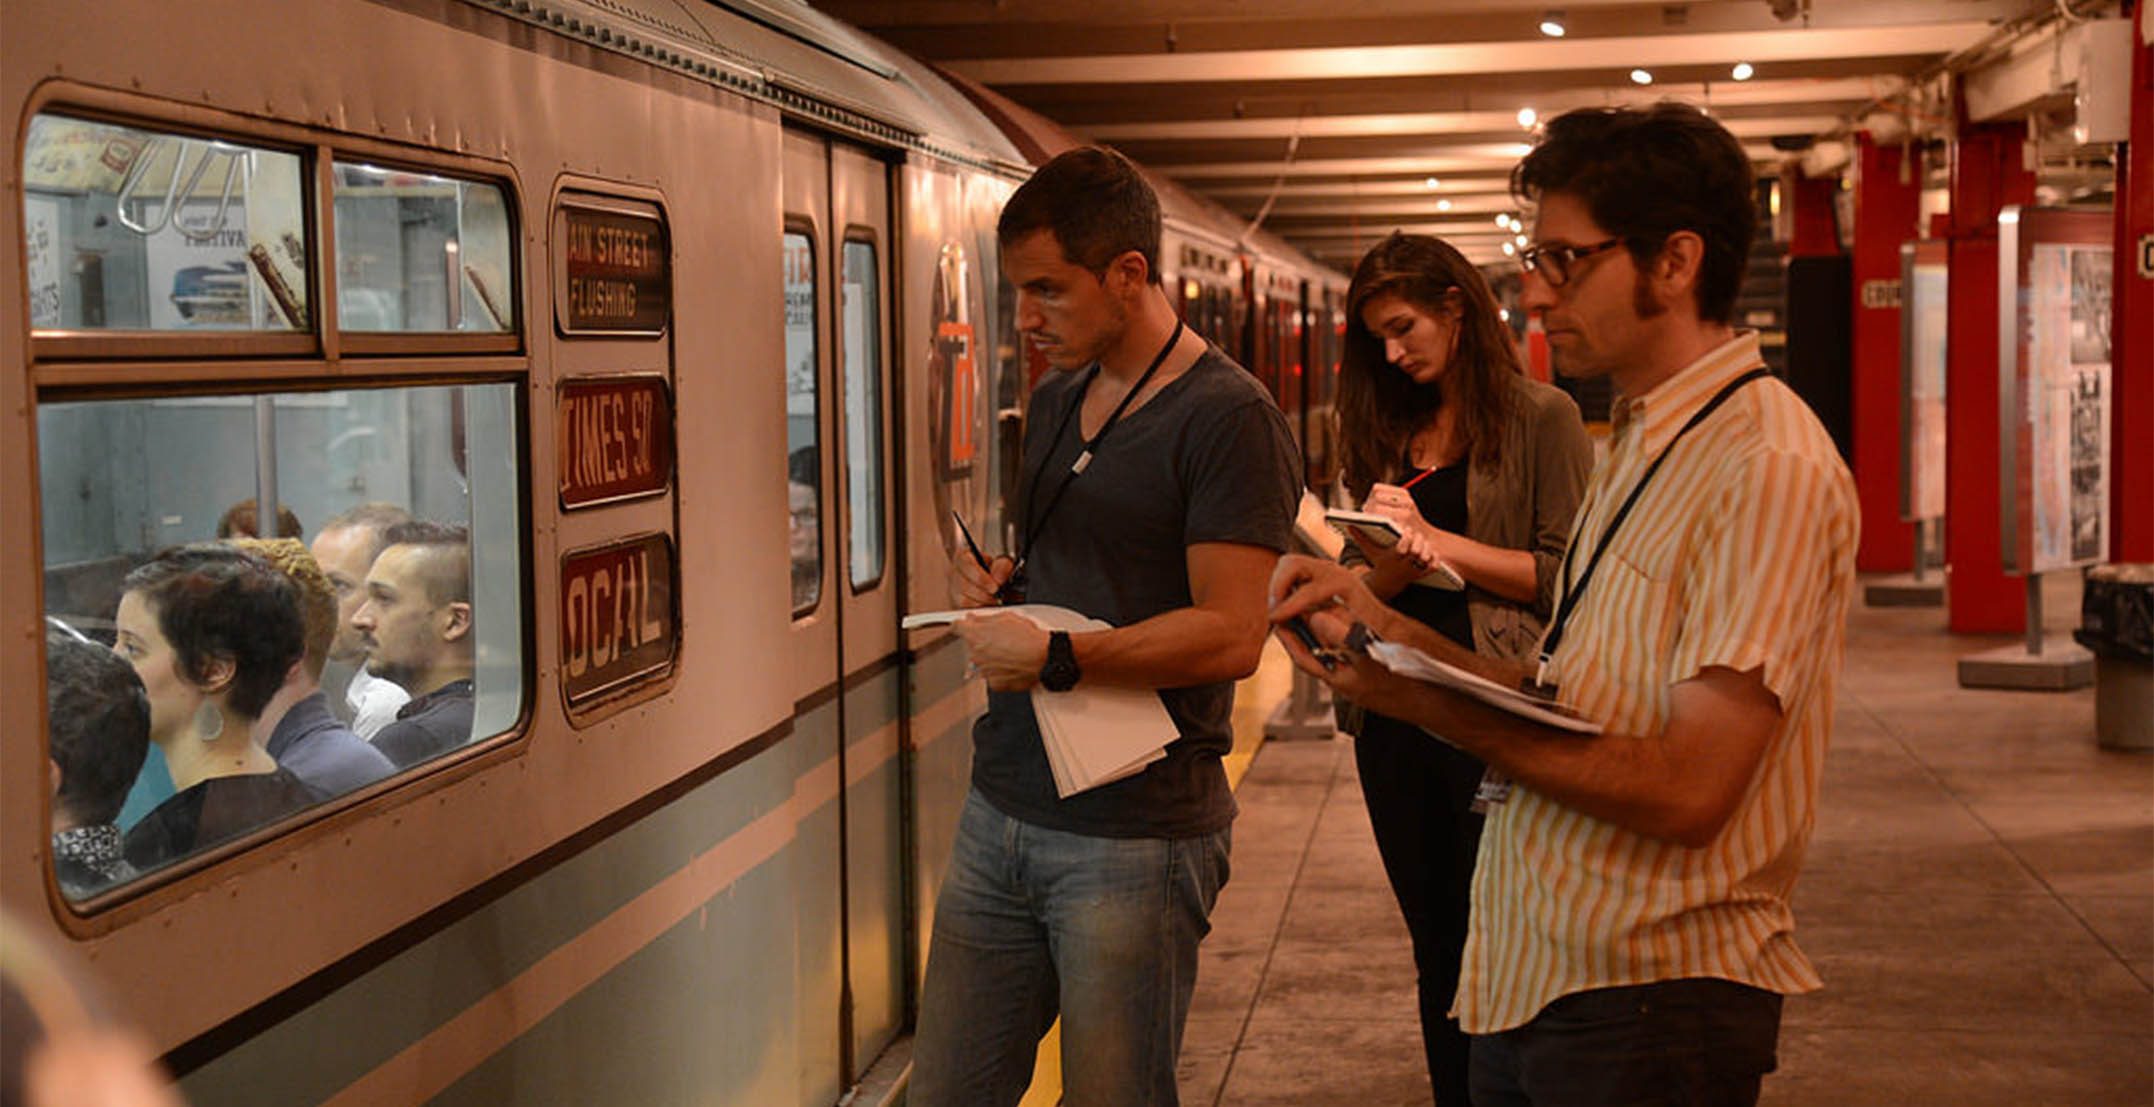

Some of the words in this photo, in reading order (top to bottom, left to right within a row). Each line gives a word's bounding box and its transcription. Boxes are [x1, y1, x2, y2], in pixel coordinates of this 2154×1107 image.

[597, 226, 649, 269] STREET
[569, 277, 637, 317] FLUSHING
[560, 392, 628, 490] TIMES
[632, 389, 653, 475] SQ
